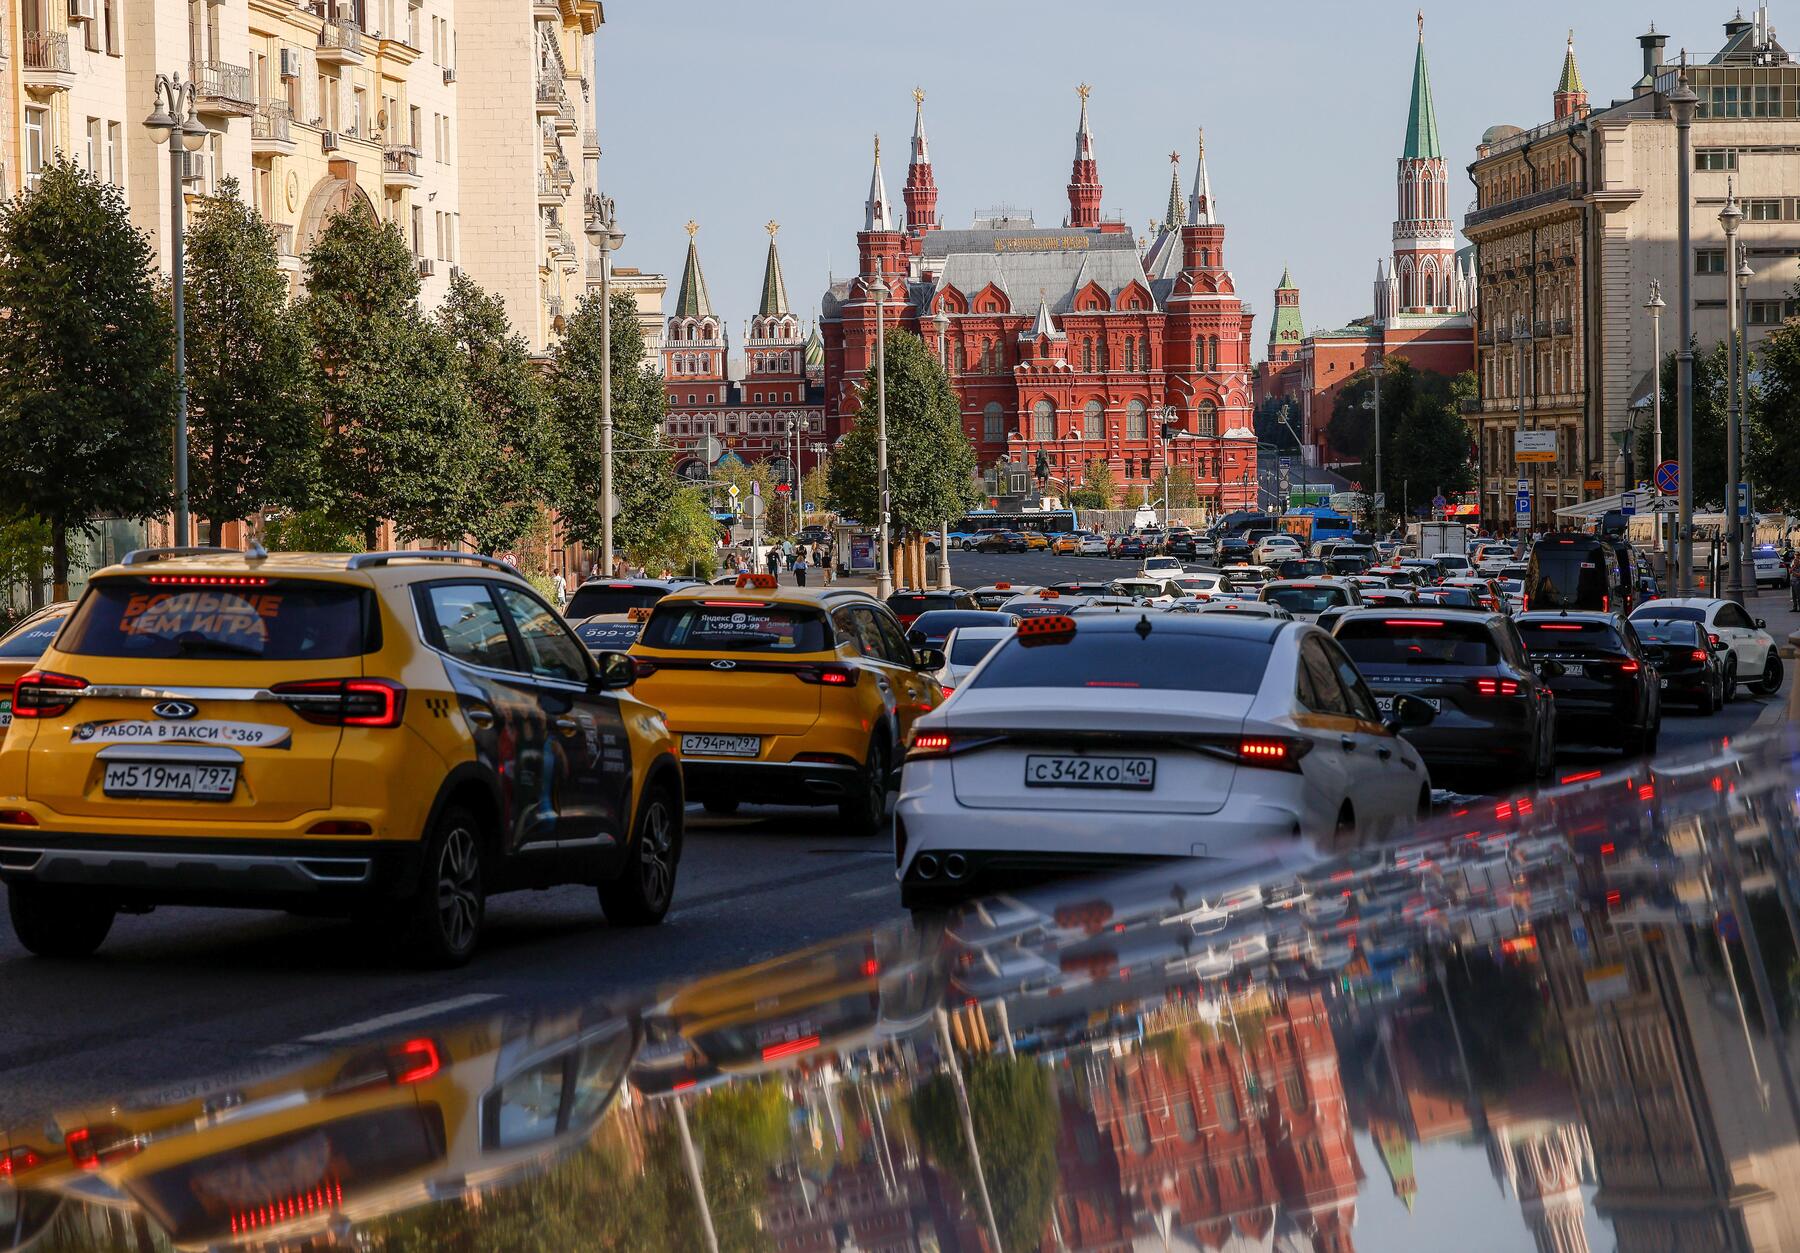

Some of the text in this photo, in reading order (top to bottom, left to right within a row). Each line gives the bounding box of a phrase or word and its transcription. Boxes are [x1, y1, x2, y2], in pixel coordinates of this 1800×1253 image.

[1520, 500, 1528, 511] P
[126, 592, 284, 617] БОЛЬШЕ
[119, 614, 270, 638] ЧЕМ ИГРА
[701, 614, 731, 622] Яндекс
[101, 725, 153, 737] РАБОТА
[158, 725, 166, 736] В
[172, 726, 218, 739] ТАКСИ
[686, 736, 756, 750] С794РМ 797
[110, 766, 231, 789] М519МА 797
[1036, 760, 1146, 780] С342КО 40
